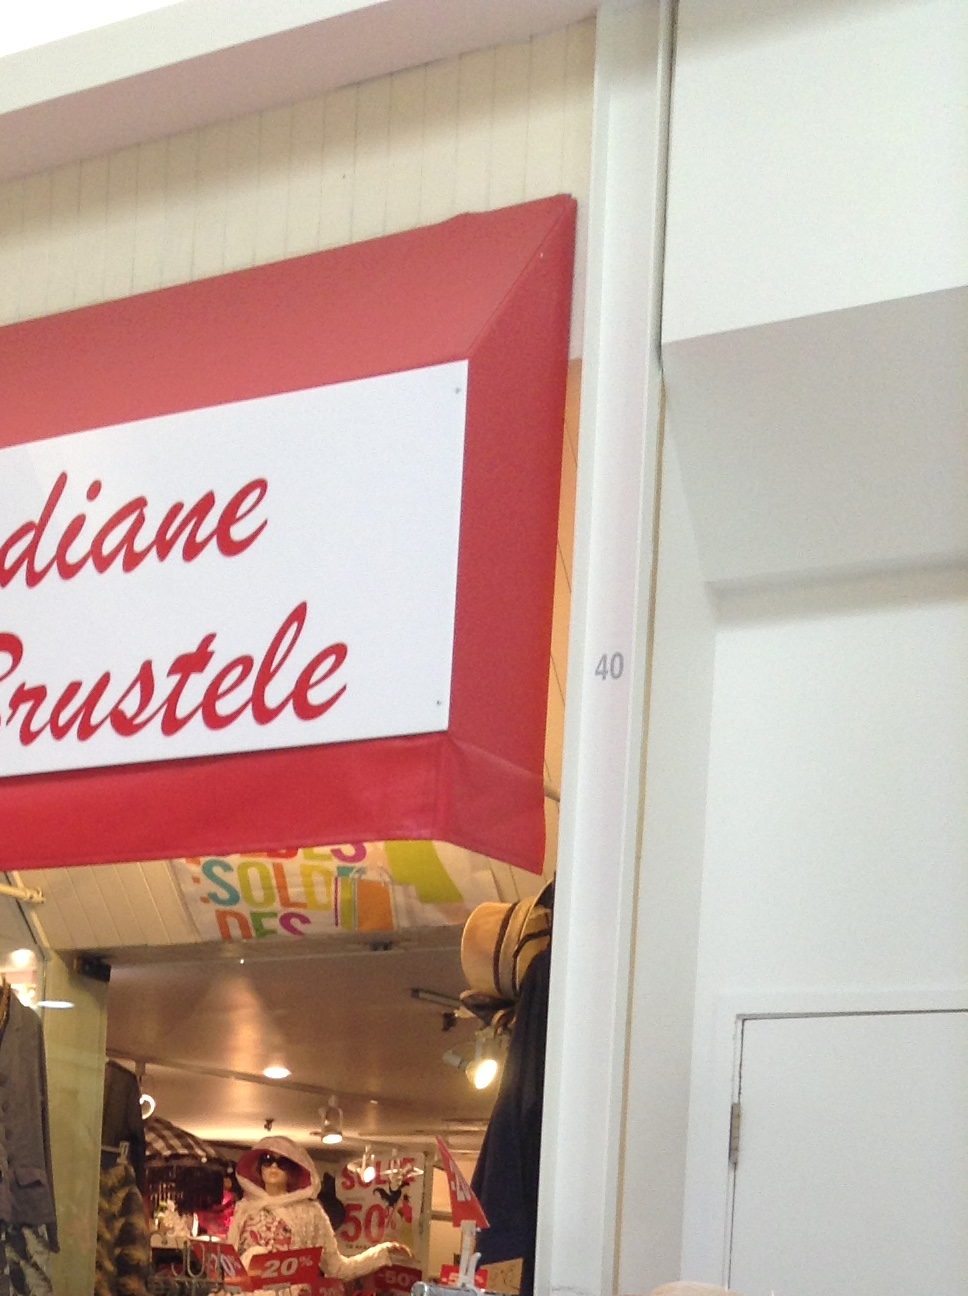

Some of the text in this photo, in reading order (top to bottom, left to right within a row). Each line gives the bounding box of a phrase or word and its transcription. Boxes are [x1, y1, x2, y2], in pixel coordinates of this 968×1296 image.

[594, 651, 624, 680] 40
[201, 858, 364, 912] SOLD
[247, 1255, 313, 1279] -20%
